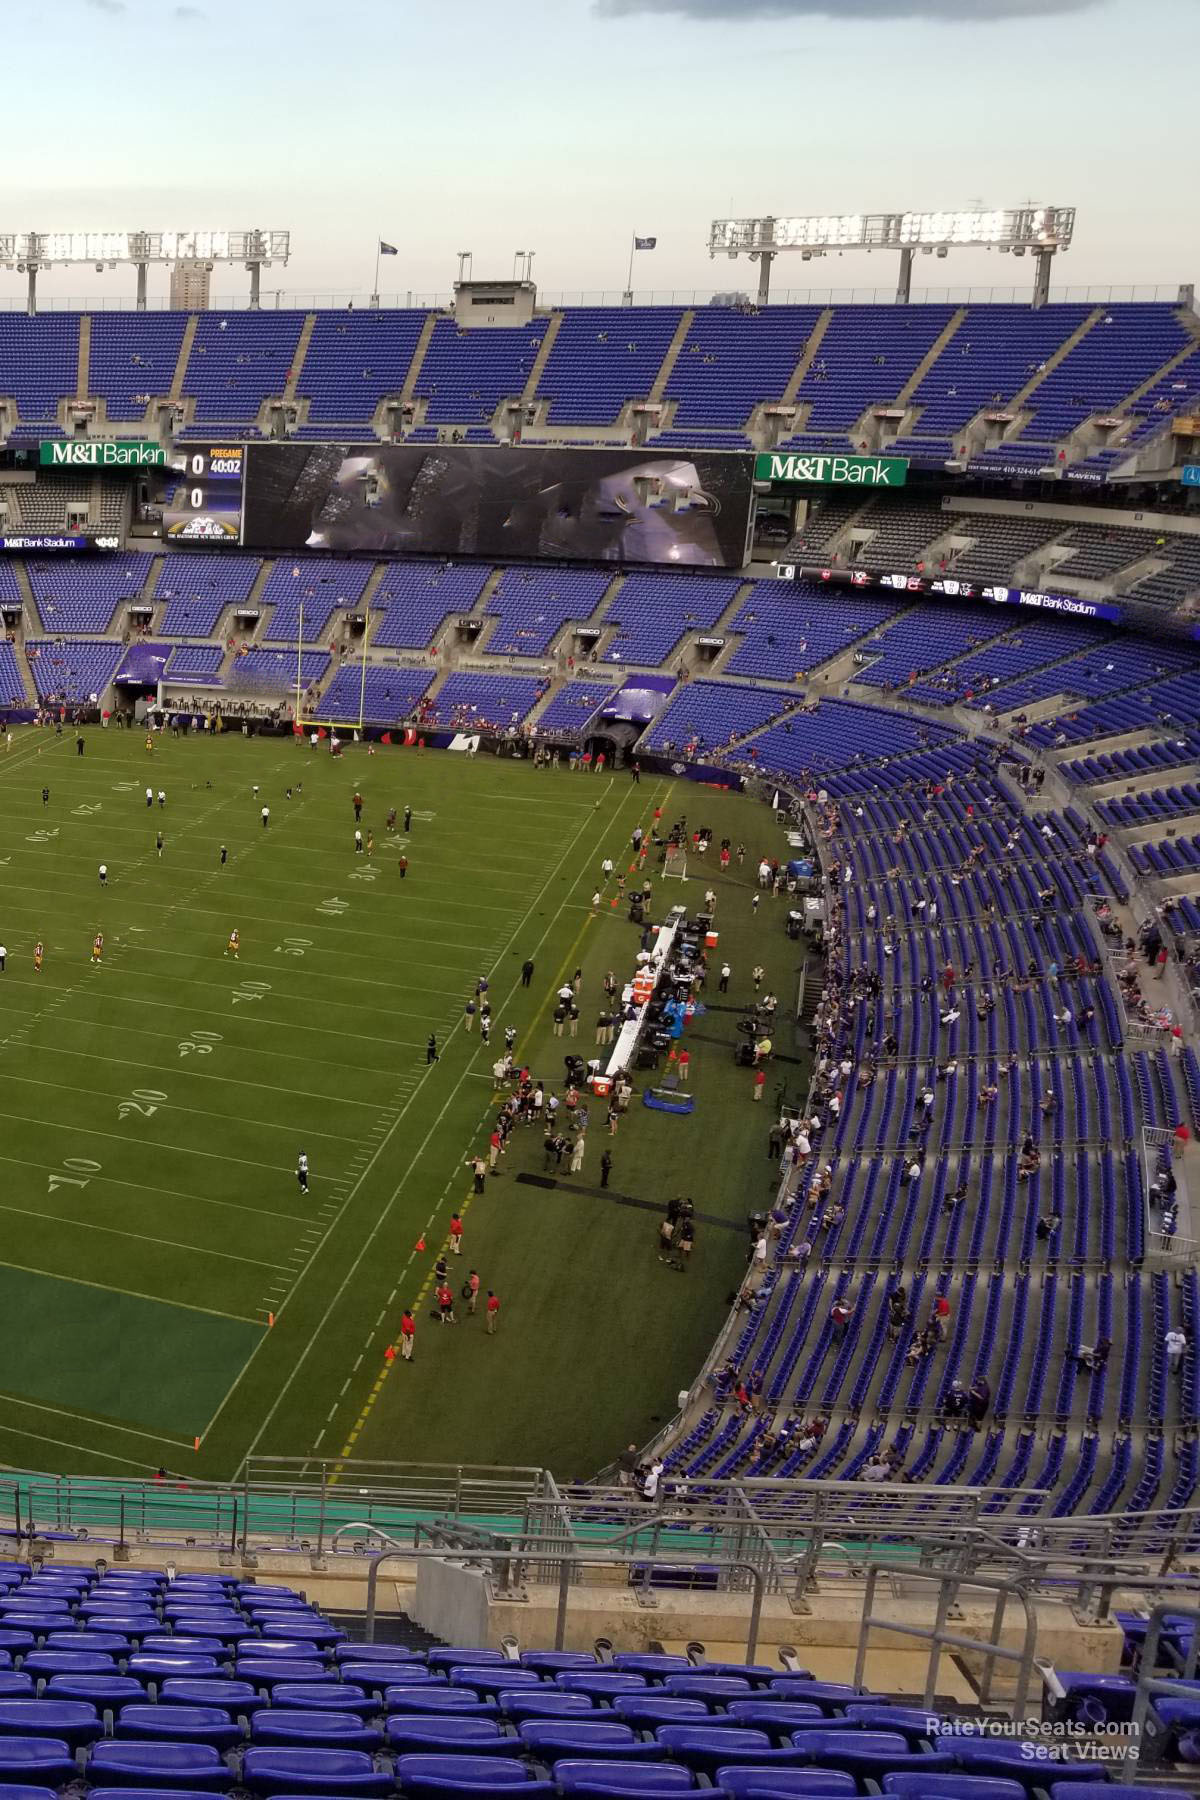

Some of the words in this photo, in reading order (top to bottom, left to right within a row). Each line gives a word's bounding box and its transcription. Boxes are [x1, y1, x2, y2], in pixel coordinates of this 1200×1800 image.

[51, 443, 102, 464] M&T
[210, 449, 243, 458] PREGAME
[192, 454, 204, 475] 0
[210, 459, 241, 473] 40:02
[769, 455, 831, 481] M&T
[831, 458, 890, 484] Bank
[1067, 472, 1101, 481] RAVENS
[191, 488, 203, 507] 0
[4, 537, 24, 548] M&T
[24, 538, 43, 548] Bank
[43, 537, 75, 548] Stadium
[1019, 592, 1043, 606] M&T
[1043, 594, 1063, 609] Bank
[1063, 599, 1096, 615] Stadium
[348, 866, 382, 881] 30
[283, 938, 313, 956] 50
[231, 981, 272, 1001] 40
[178, 1031, 224, 1054] 30
[117, 1089, 168, 1117] 20
[48, 1158, 102, 1189] 10
